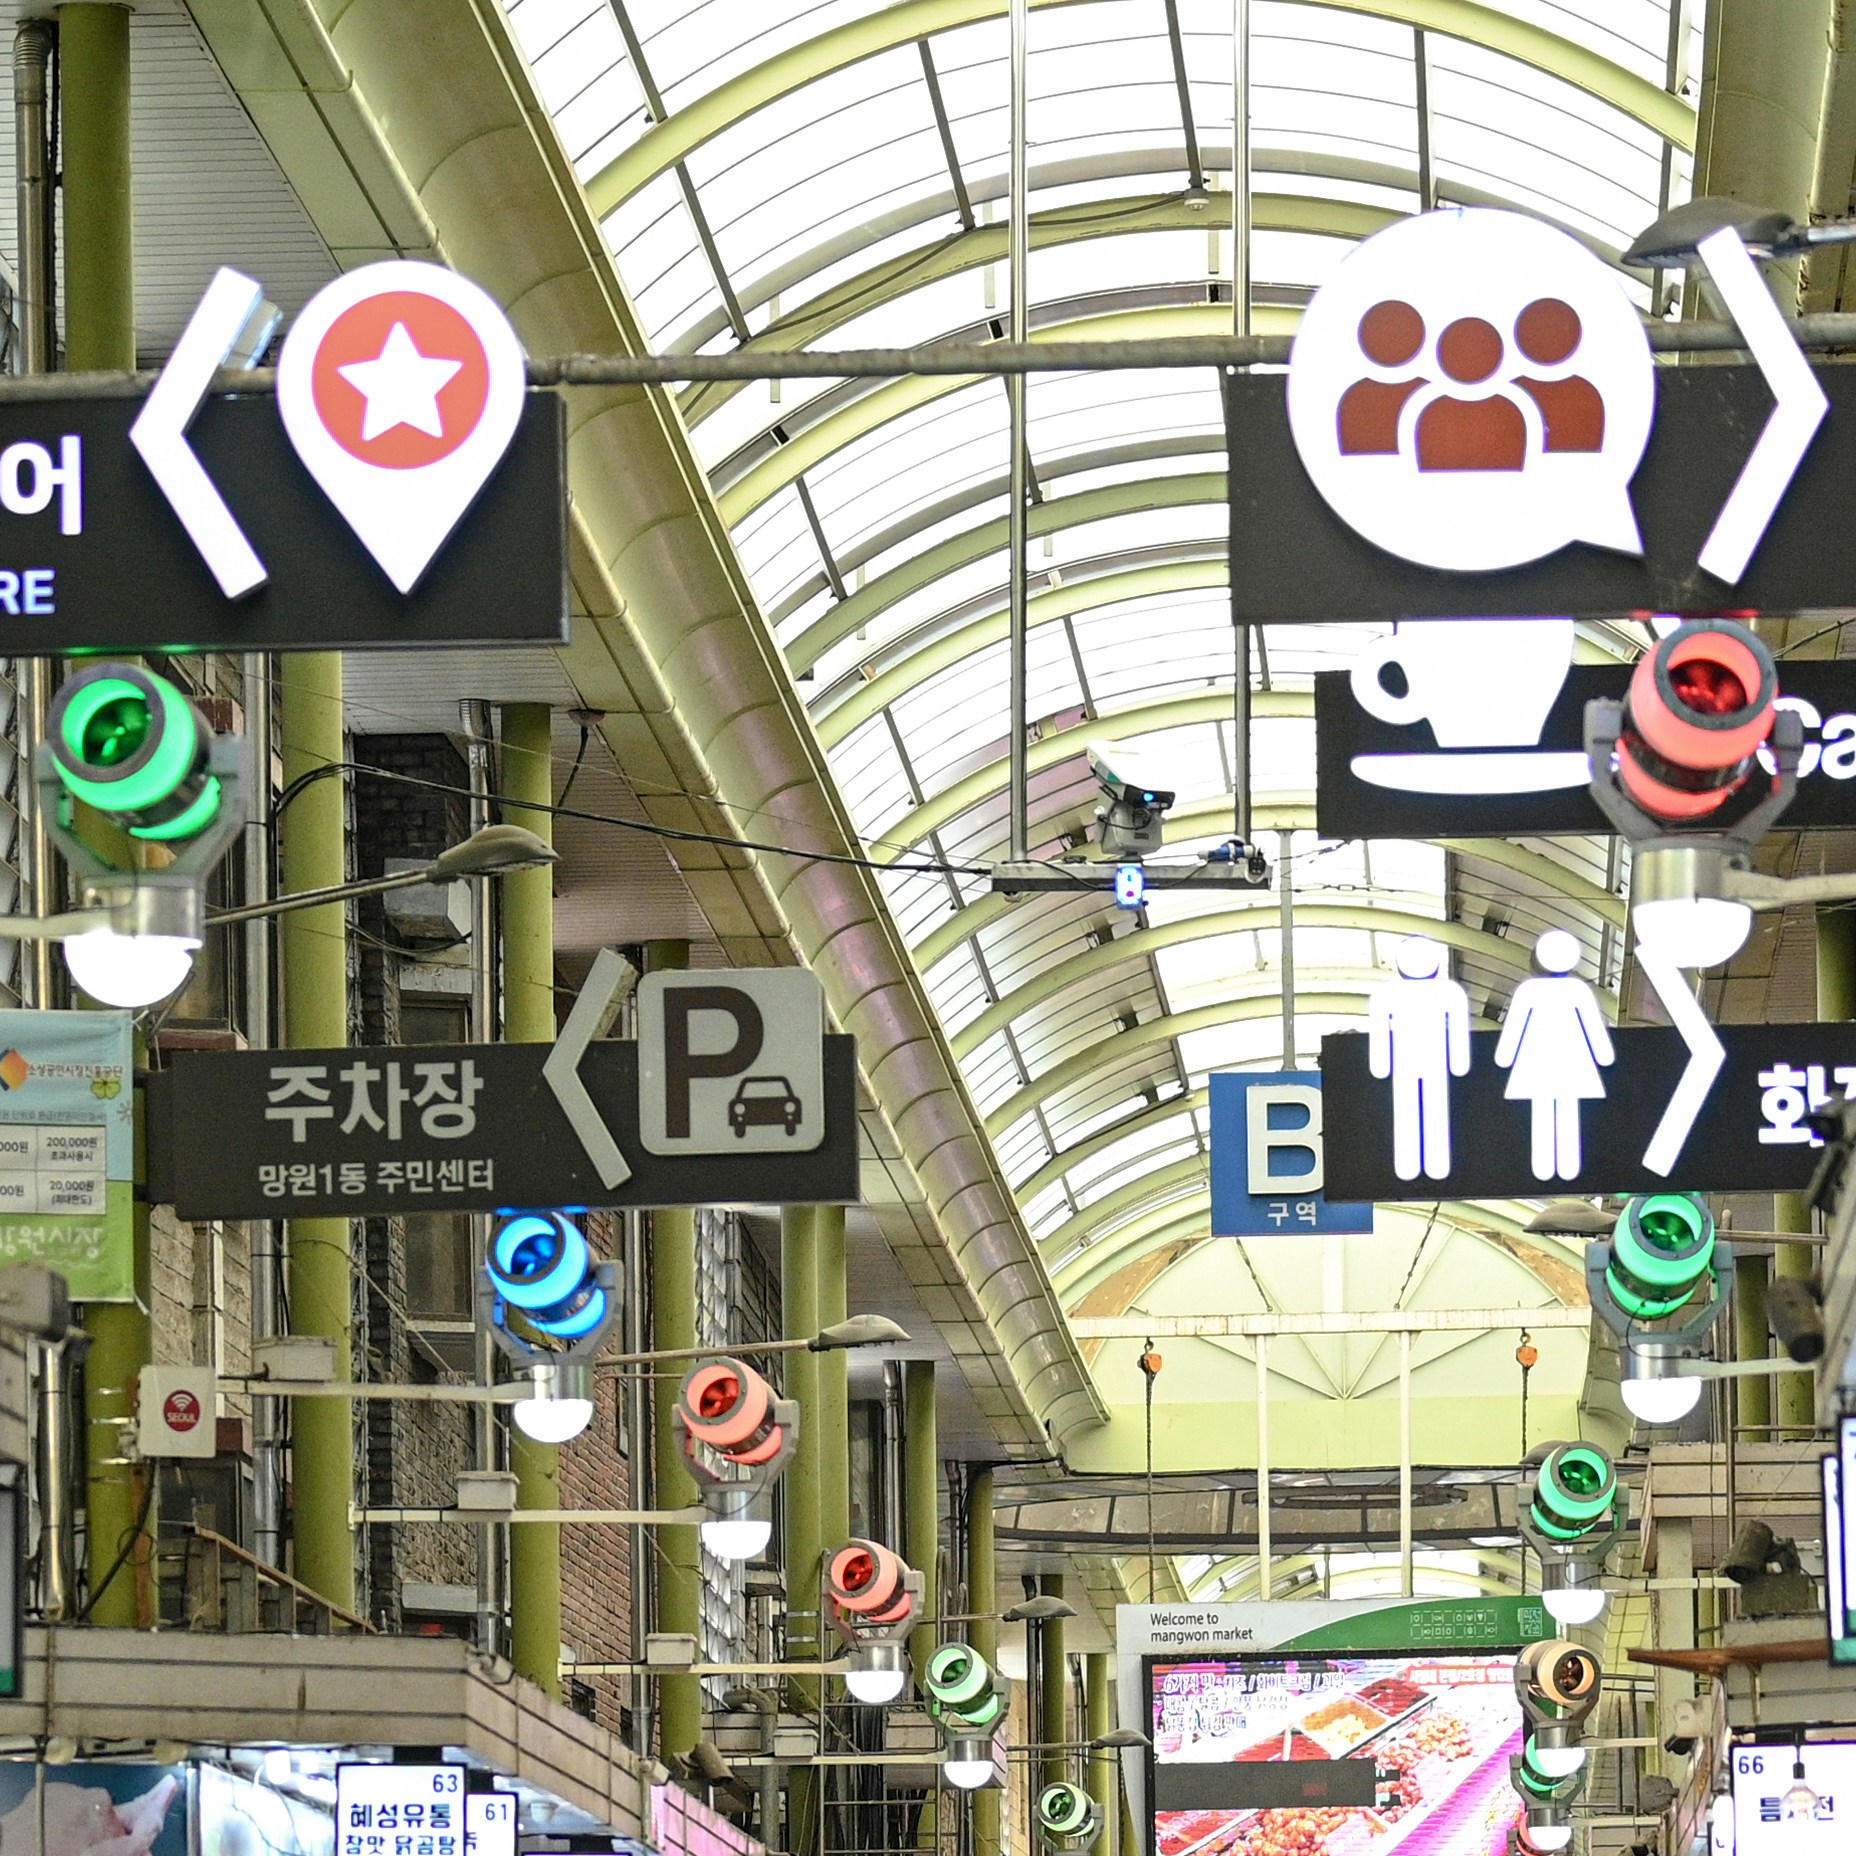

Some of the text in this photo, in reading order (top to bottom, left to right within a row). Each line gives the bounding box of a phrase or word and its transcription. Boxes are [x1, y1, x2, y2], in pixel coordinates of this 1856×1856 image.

[663, 986, 765, 1140] P
[263, 1059, 485, 1144] 주차장
[46, 1136, 97, 1149] 200,000원
[1247, 1084, 1325, 1195] B
[49, 1180, 94, 1192] 20,000원
[258, 1160, 495, 1197] 망원1동 주민센터
[1267, 1202, 1318, 1227] 구역
[166, 1410, 199, 1422] SEOUL
[1150, 1612, 1219, 1626] Welcome to
[1150, 1627, 1253, 1644] mangwon market
[1738, 1756, 1764, 1774] 66
[432, 1773, 459, 1794] 63
[350, 1804, 452, 1829] 혜성유통
[485, 1803, 508, 1821] 61
[345, 1835, 383, 1856] 참맛
[395, 1835, 457, 1856] 닭곰탕
